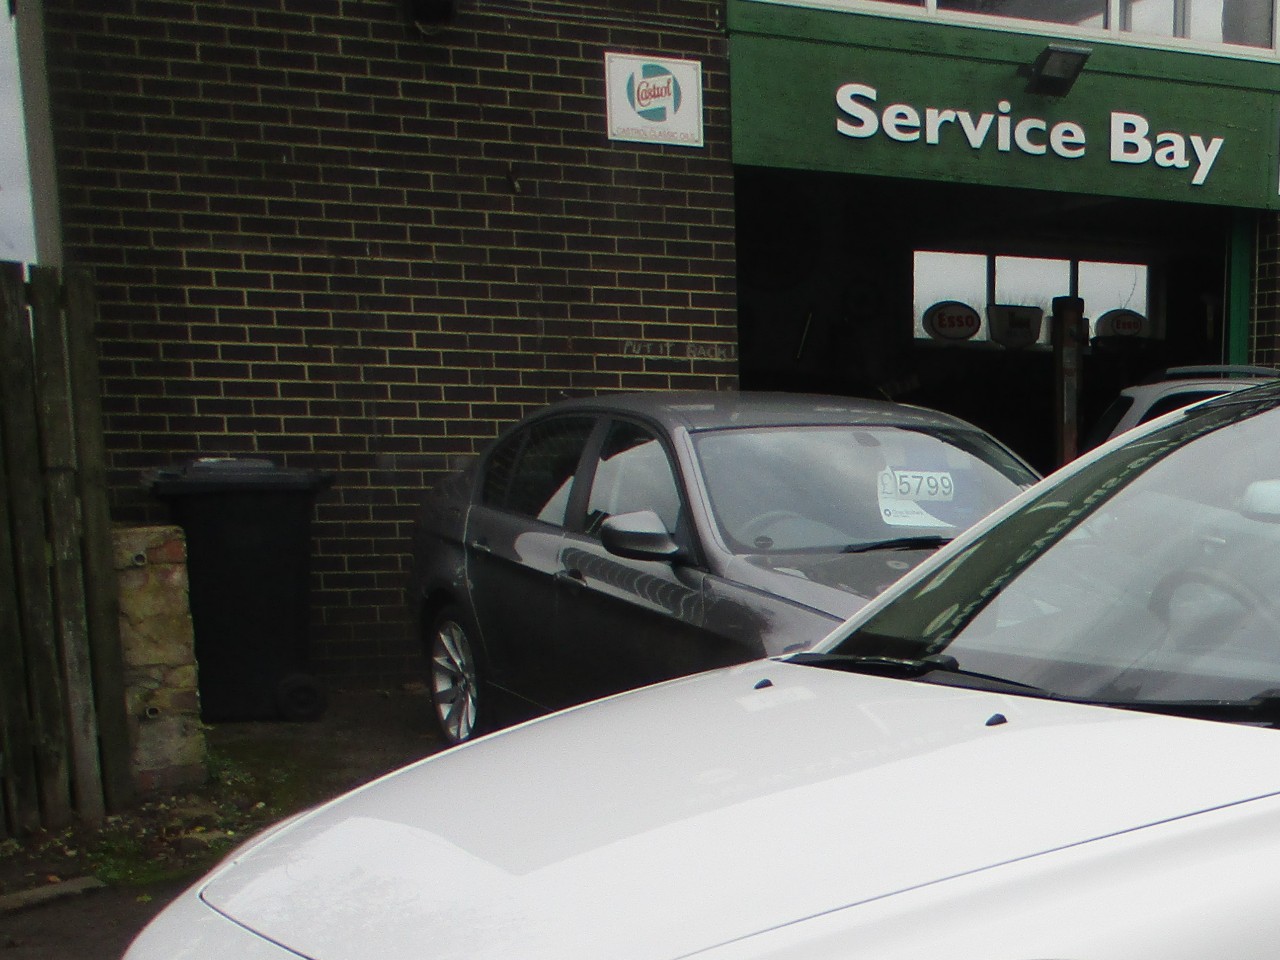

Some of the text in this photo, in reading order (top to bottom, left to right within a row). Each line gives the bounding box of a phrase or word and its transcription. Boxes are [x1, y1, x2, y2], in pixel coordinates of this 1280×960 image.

[637, 77, 672, 107] Castrol
[835, 83, 1225, 185] Service Bay
[937, 312, 975, 329] Esso
